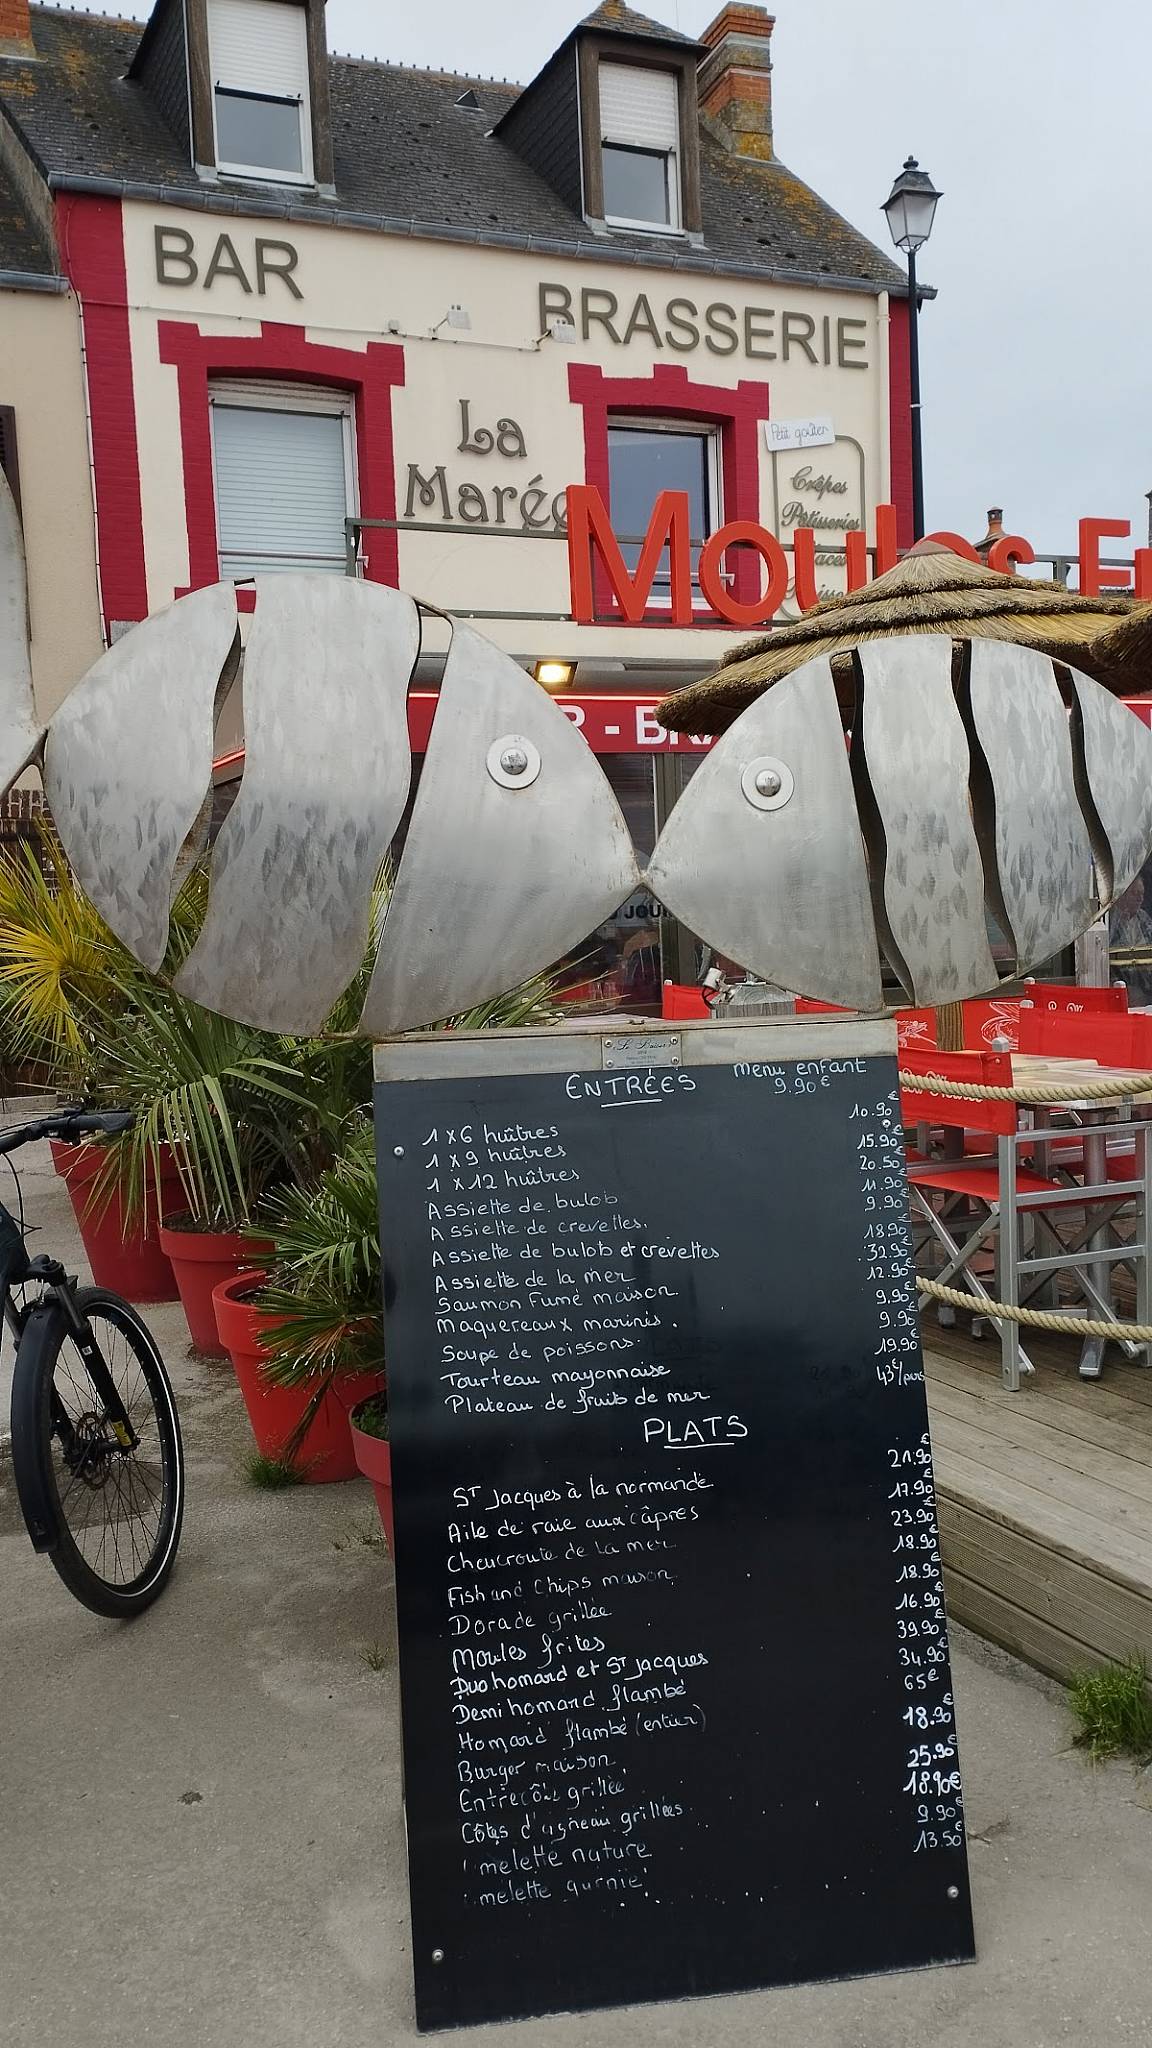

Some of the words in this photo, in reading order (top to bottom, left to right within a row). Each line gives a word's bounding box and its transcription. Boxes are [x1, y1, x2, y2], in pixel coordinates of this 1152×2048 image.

[154, 224, 304, 299] BAR
[539, 281, 868, 369] BRASSERIE
[457, 399, 527, 457] La
[790, 465, 848, 500] Crêpes
[781, 501, 860, 531] Pâtisseries
[566, 1069, 697, 1099] ENTRÉES
[484, 1124, 560, 1145] huîtres
[488, 1145, 567, 1163] huîtres
[505, 1169, 580, 1188] huîtres
[427, 1202, 511, 1220] Assiette
[518, 1200, 545, 1214] de
[430, 1221, 519, 1241] Assiette
[527, 1220, 548, 1235] de
[432, 1243, 512, 1268] Assiette
[519, 1244, 542, 1259] de
[620, 1241, 635, 1257] et
[641, 1241, 720, 1259] crevettes
[435, 1271, 519, 1293] Assiette
[525, 1269, 547, 1287] de
[558, 1269, 575, 1284] la
[584, 1271, 637, 1283] mer
[435, 1298, 521, 1315] Saumon
[437, 1319, 572, 1338] Maquereaux
[441, 1346, 499, 1366] Soupe
[509, 1342, 531, 1359] de
[439, 1368, 540, 1389] Tourteau
[551, 1363, 671, 1388] mayonnaise
[445, 1395, 533, 1414] Plateau
[544, 1397, 566, 1411] de
[635, 1388, 658, 1405] de
[668, 1392, 711, 1402] mer
[643, 1416, 747, 1443] PLATS
[566, 1481, 582, 1499] à
[590, 1473, 609, 1499] la
[615, 1472, 713, 1496] normande
[448, 1521, 489, 1544] Aile
[498, 1519, 523, 1537] de
[531, 1518, 577, 1534] raie
[585, 1516, 625, 1528] aux
[565, 1541, 585, 1559] de
[596, 1541, 619, 1555] la
[447, 1582, 485, 1608] Fish
[448, 1611, 536, 1636] Dorade
[549, 1599, 612, 1632] grillée
[452, 1643, 527, 1673] Moules
[537, 1633, 606, 1669] frites
[450, 1676, 488, 1698] Duo
[491, 1664, 567, 1690] homard
[577, 1662, 599, 1679] et
[452, 1703, 501, 1724] Demi
[508, 1690, 595, 1717] homard
[605, 1679, 686, 1712] flambé
[458, 1727, 547, 1753] Homard
[564, 1717, 627, 1750] flambé
[457, 1759, 527, 1785] Burger
[535, 1754, 616, 1774] maison
[461, 1822, 508, 1844] Côtes
